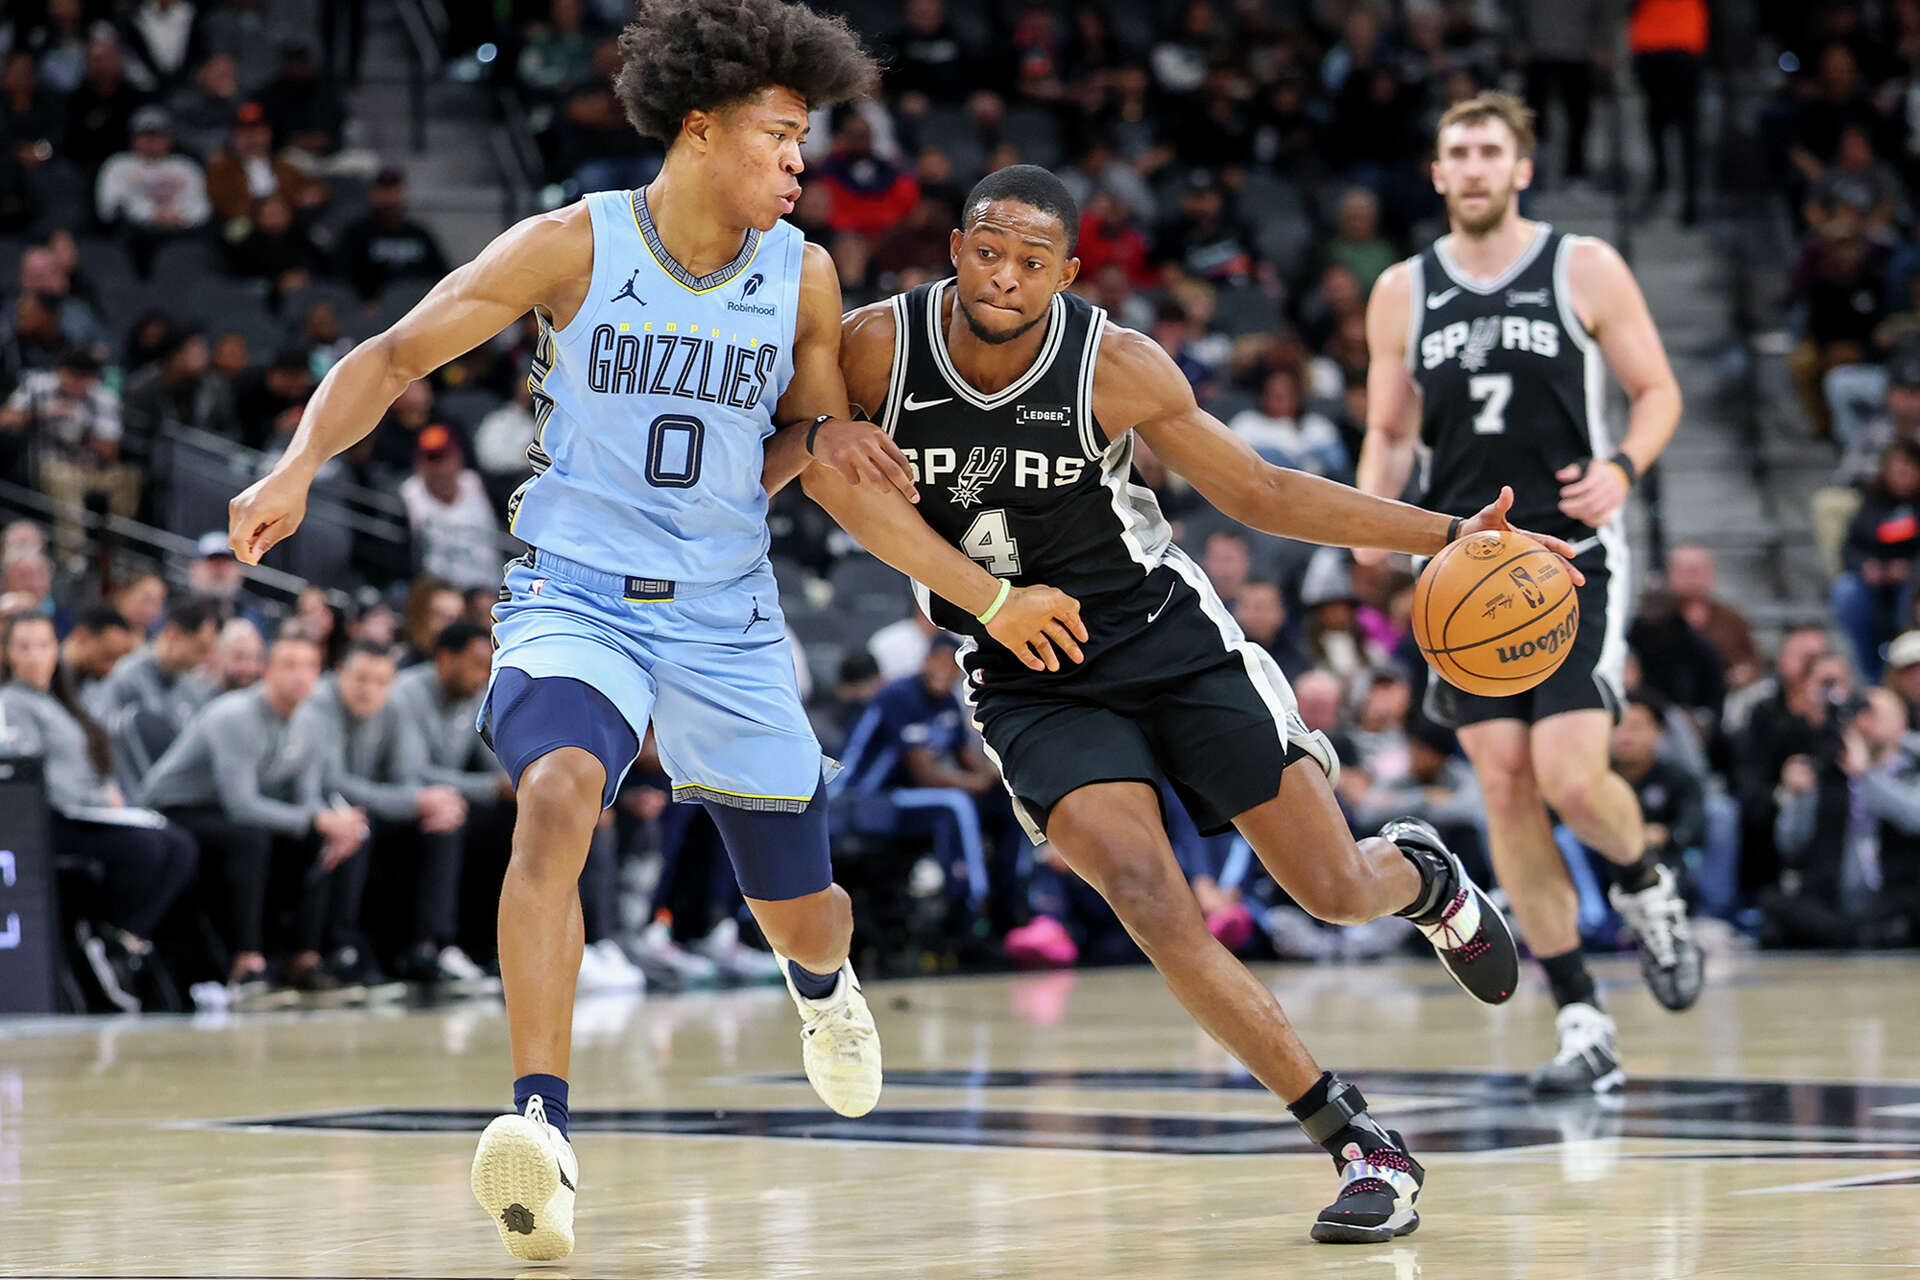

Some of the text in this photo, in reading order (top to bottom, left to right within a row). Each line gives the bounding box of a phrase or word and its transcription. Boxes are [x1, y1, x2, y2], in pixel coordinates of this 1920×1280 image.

[619, 321, 759, 349] MEMPHIS
[727, 301, 776, 316] Robinhood
[588, 323, 778, 410] GRIZZLIES
[1421, 315, 1559, 373] SPURS
[1023, 410, 1065, 422] LEDGER
[1468, 372, 1514, 435] 7
[644, 413, 706, 489] 0
[959, 508, 1023, 577] 4
[1496, 604, 1579, 664] Wilson
